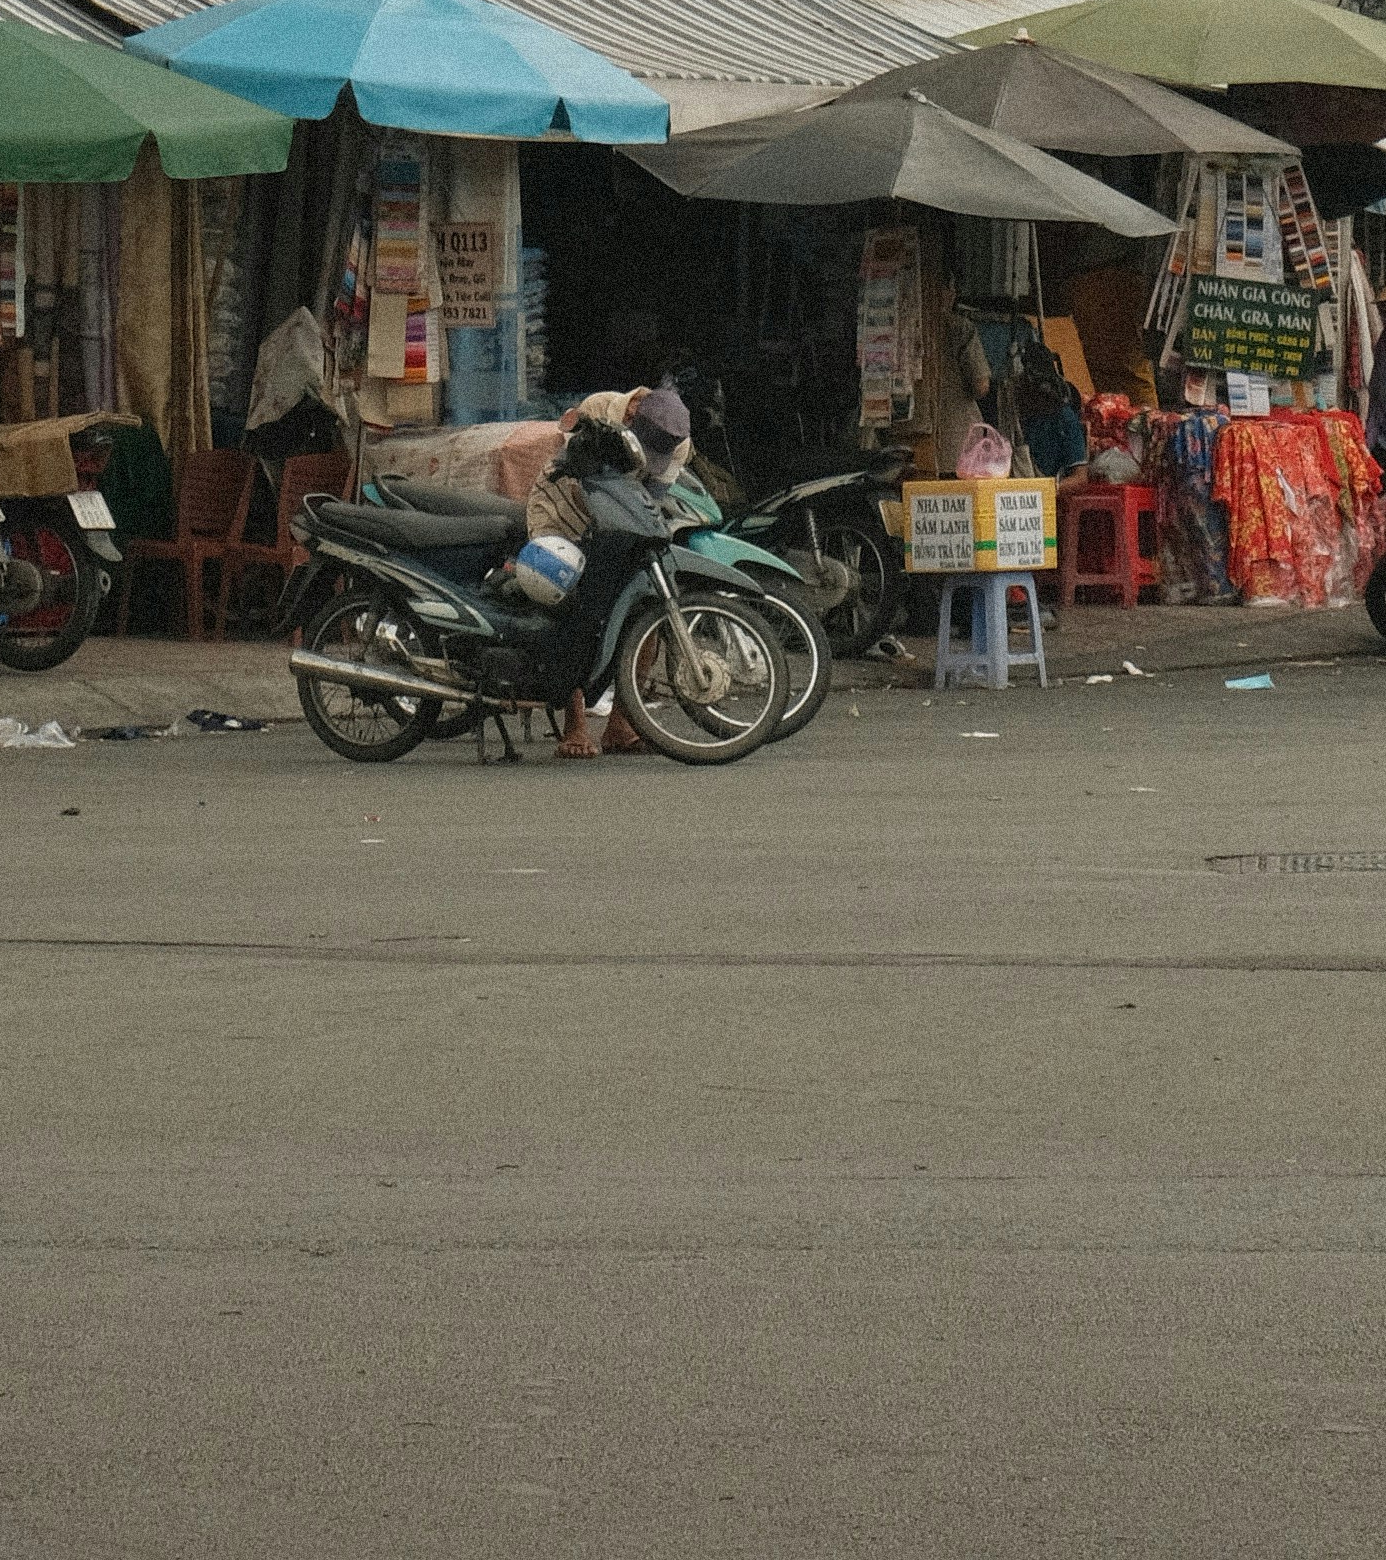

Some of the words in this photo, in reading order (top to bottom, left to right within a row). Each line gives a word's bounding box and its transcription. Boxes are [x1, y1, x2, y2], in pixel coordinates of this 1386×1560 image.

[451, 231, 488, 254] Q113
[1197, 280, 1239, 301] NHẬN
[1242, 286, 1268, 303] GIA
[1271, 288, 1312, 309] CÔNG
[917, 499, 940, 513] NHA
